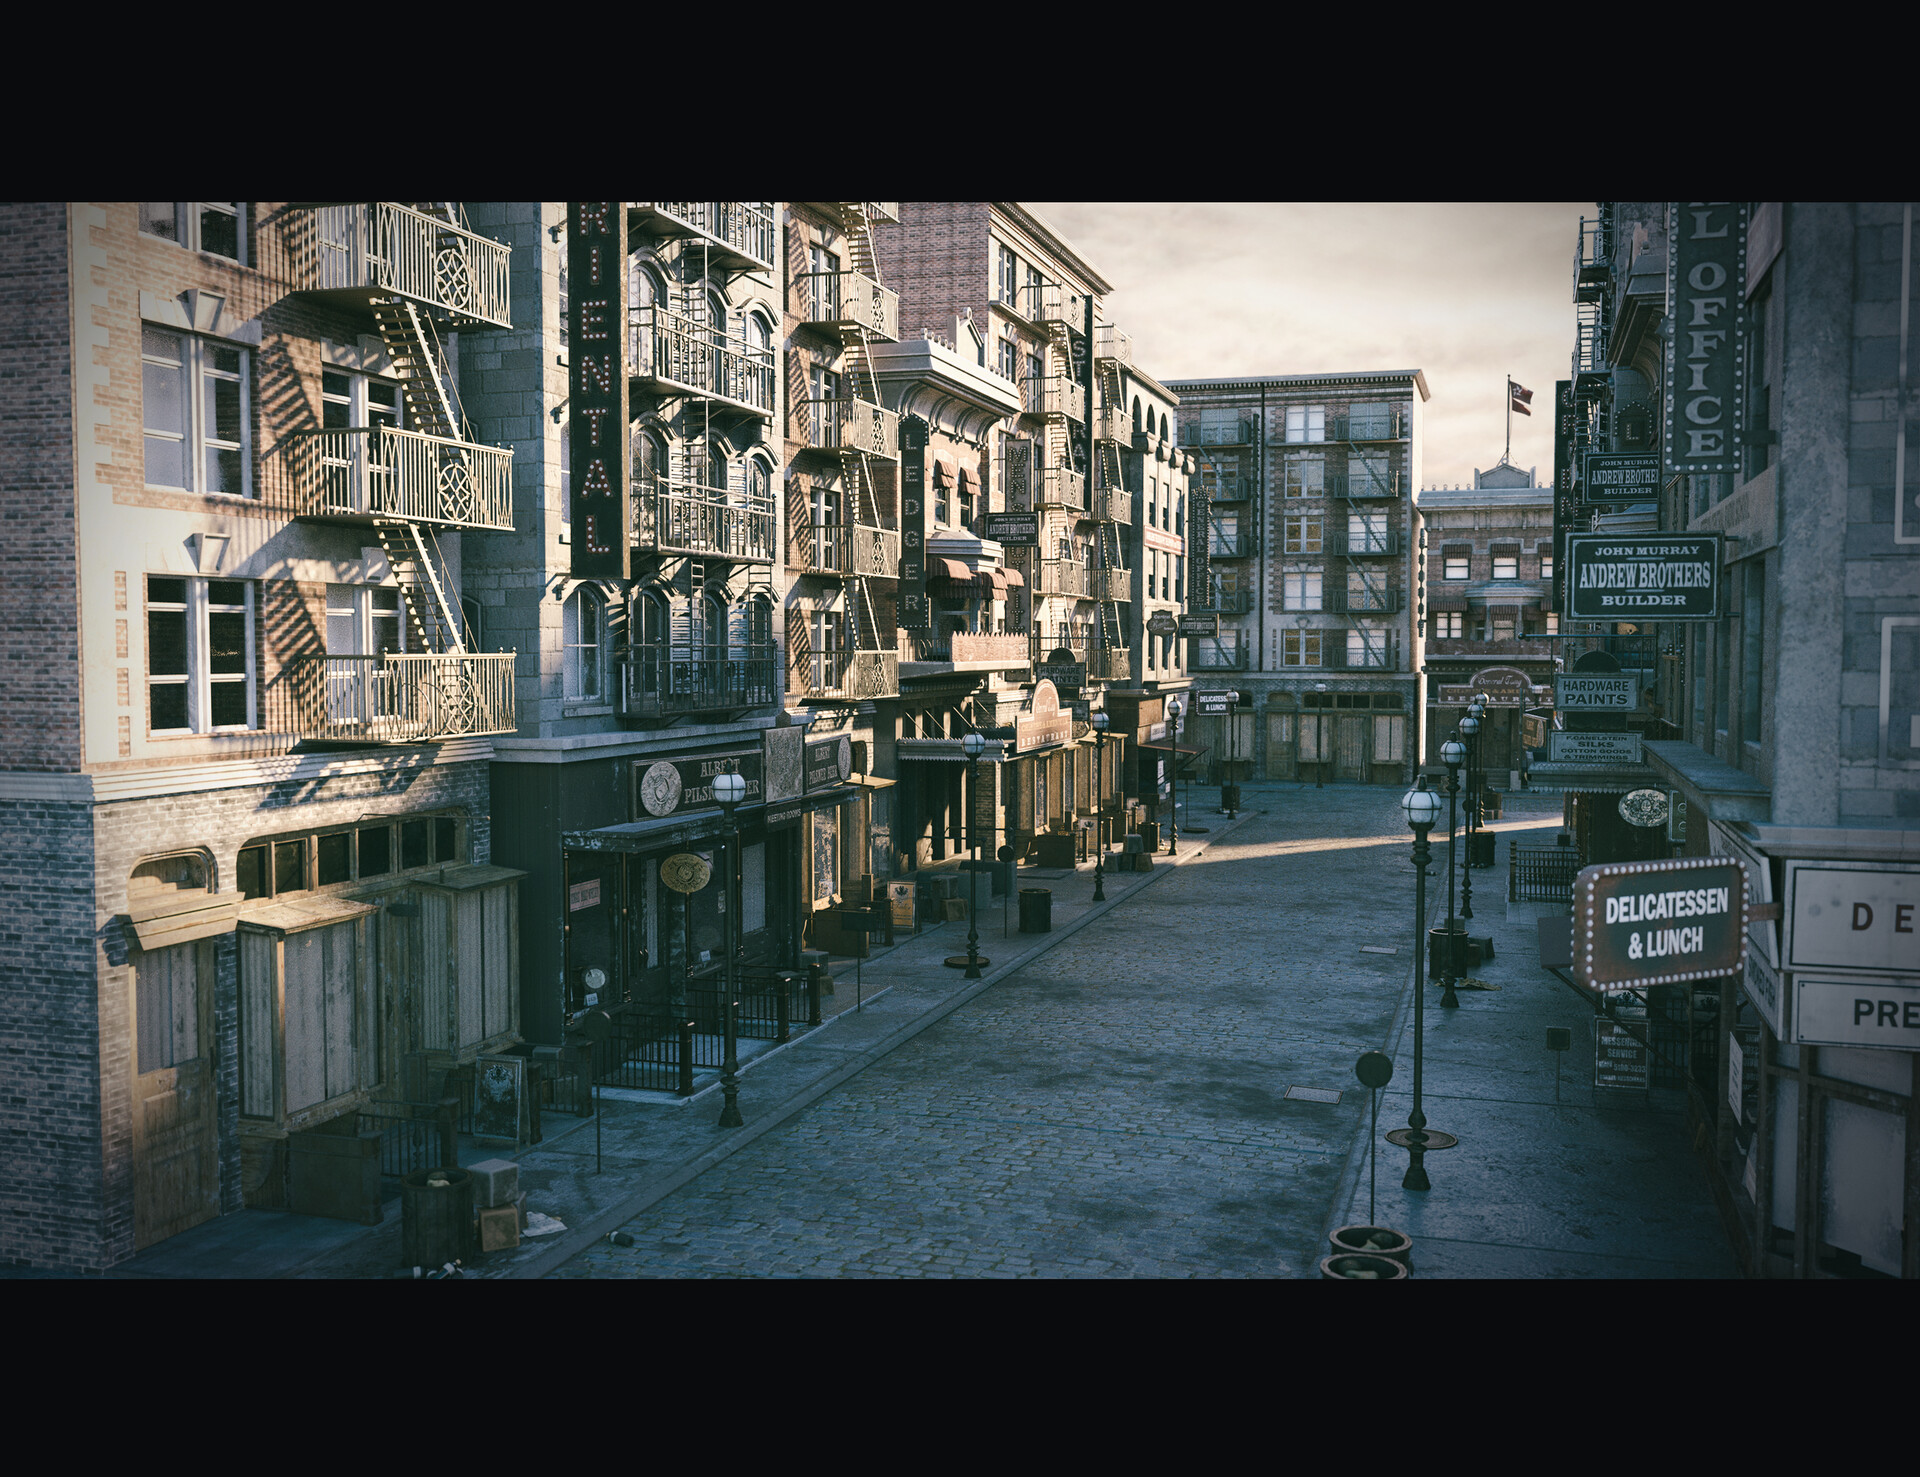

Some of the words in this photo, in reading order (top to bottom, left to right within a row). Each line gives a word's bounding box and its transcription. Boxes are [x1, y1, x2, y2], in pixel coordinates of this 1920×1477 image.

[1684, 261, 1728, 458] OFFICE
[1591, 469, 1625, 485] ANDREW
[1625, 468, 1658, 484] BROTHE
[1604, 487, 1652, 495] BUILDER
[904, 433, 919, 610] LEDGER
[1195, 500, 1206, 553] GENERAL
[1595, 546, 1634, 556] JOHN
[1635, 545, 1701, 556] MURRAY
[1195, 557, 1205, 602] OFFICE
[1579, 562, 1638, 589] ANDREW
[1638, 560, 1711, 589] BROTHERS
[1601, 595, 1687, 607] BUILDER
[1040, 666, 1080, 674] HARDWARE
[1563, 680, 1629, 691] HARDWARE
[1200, 695, 1228, 703] DELICATESS
[1205, 703, 1209, 711] &
[1210, 703, 1226, 711] LUNCH
[1565, 694, 1628, 705] PAINTS
[700, 757, 740, 778] ALBET
[1605, 887, 1729, 925] DELICATESSEN
[1628, 932, 1643, 960] &
[1646, 926, 1704, 957] LUNCH
[1853, 998, 1920, 1029] PRE
[1607, 1048, 1638, 1059] SERVICE
